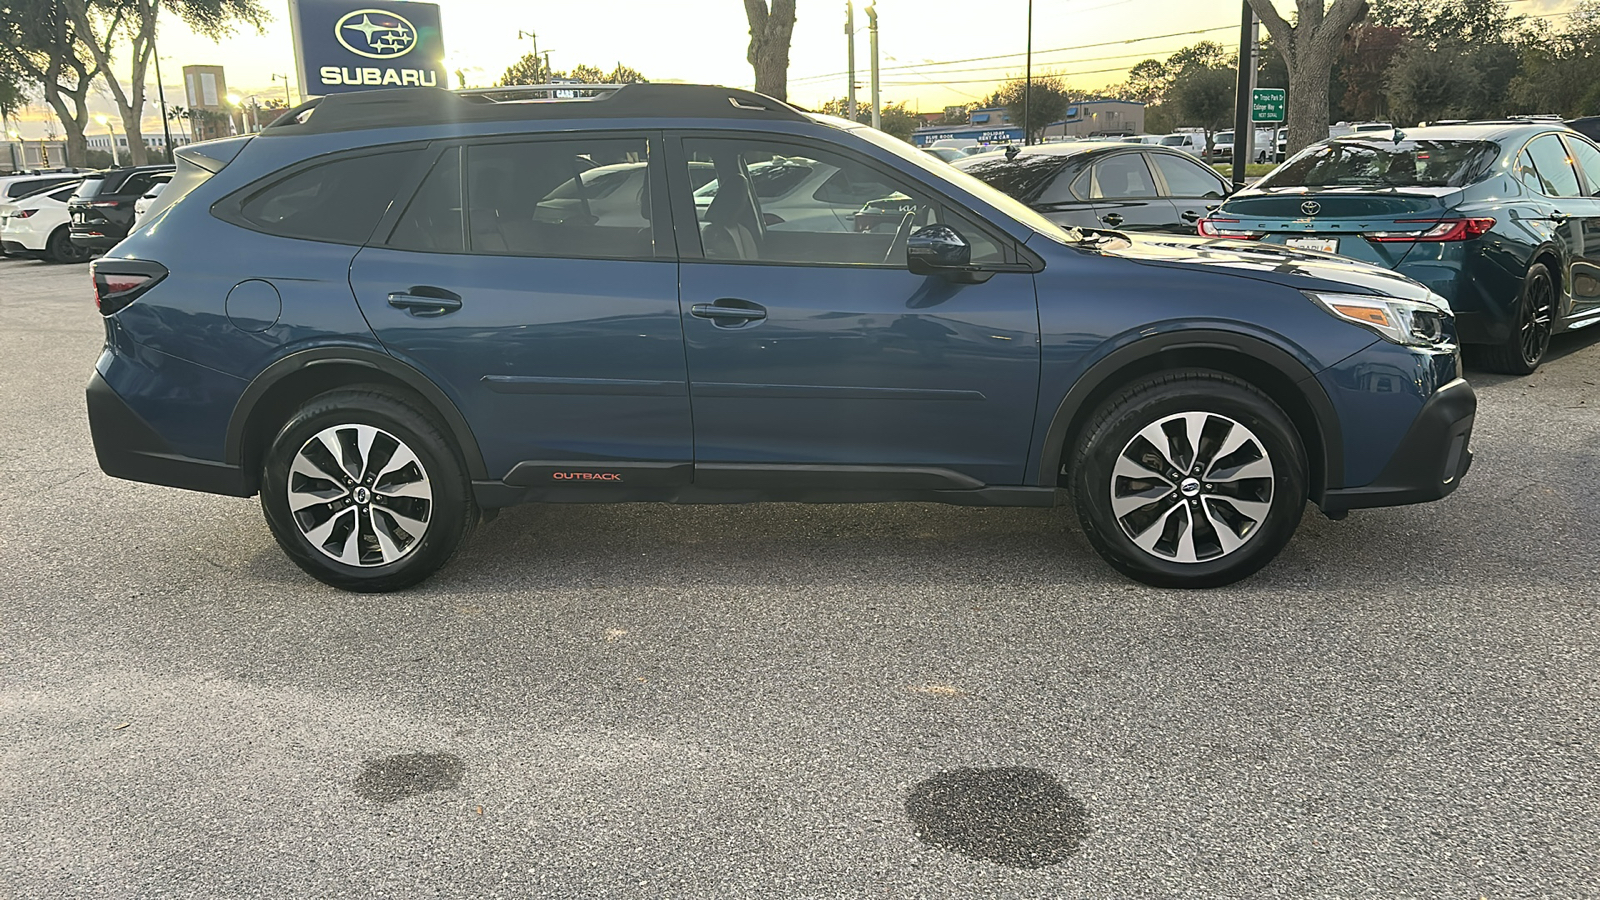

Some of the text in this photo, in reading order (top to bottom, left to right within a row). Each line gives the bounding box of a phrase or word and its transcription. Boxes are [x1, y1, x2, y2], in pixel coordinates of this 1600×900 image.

[320, 66, 437, 87] SUBARU
[1260, 94, 1270, 102] Tropic
[1267, 104, 1275, 112] Way
[553, 472, 621, 480] OUTBACK
